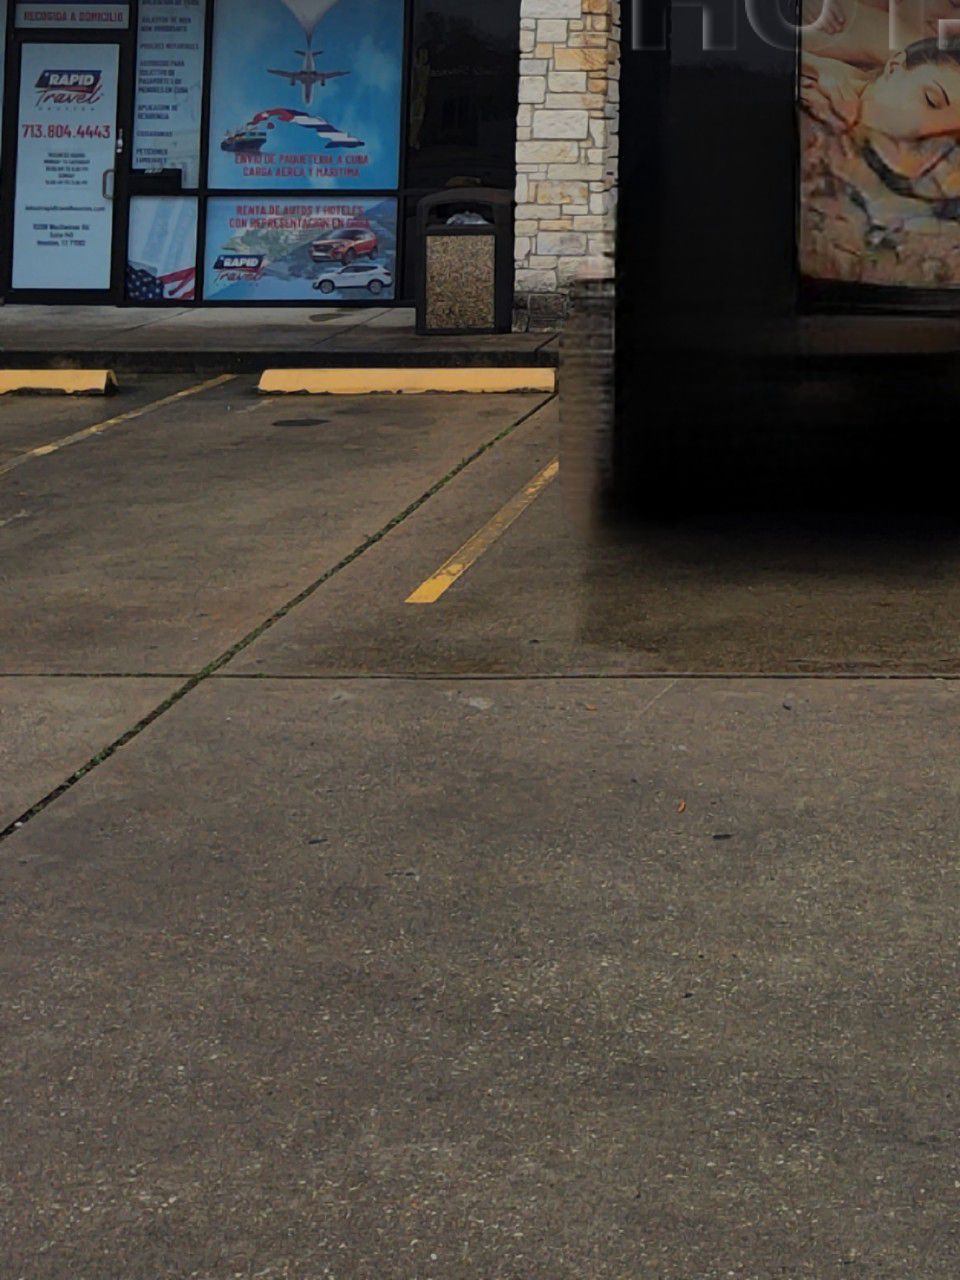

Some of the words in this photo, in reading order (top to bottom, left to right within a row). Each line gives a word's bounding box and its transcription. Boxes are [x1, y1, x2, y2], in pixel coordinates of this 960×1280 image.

[48, 73, 95, 86] RAPID
[35, 84, 103, 107] Travel
[22, 124, 111, 139] 713.804.4443
[223, 257, 259, 267] RAPID
